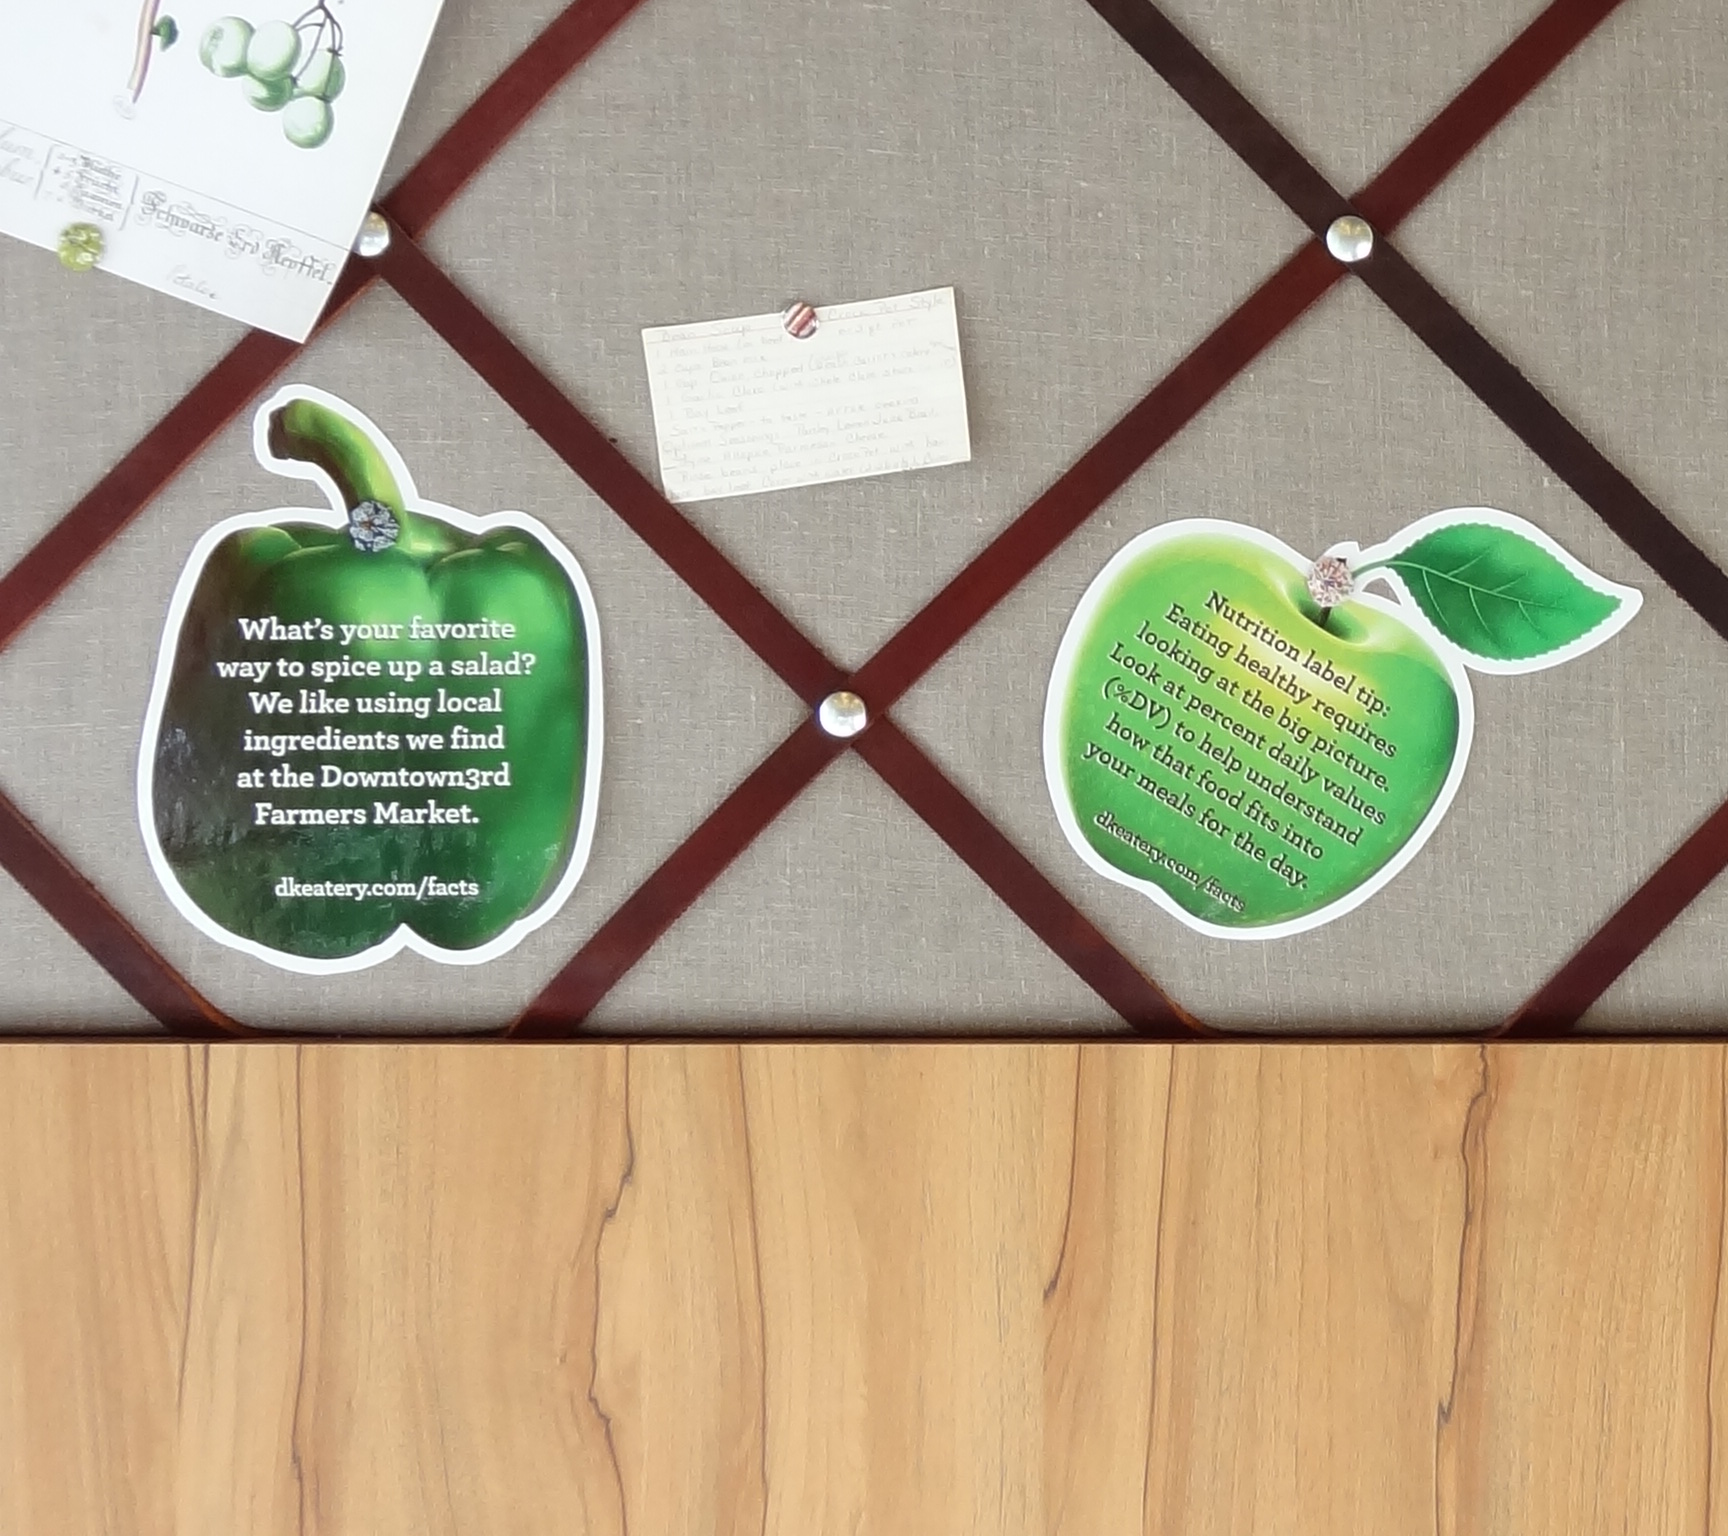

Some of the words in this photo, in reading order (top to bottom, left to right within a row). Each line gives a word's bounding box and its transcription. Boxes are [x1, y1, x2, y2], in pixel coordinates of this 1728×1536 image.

[238, 616, 334, 642] What's
[339, 622, 404, 647] your
[408, 616, 516, 641] favorite
[216, 660, 272, 684] way
[276, 657, 305, 678] to
[310, 653, 382, 684] spice
[387, 659, 425, 684] up
[429, 658, 446, 677] a
[450, 651, 537, 677] salad?
[1201, 589, 1302, 666] Nutrition
[1301, 648, 1357, 698] label
[1355, 680, 1393, 719] tip:
[1164, 601, 1234, 659] Eating
[1235, 640, 1312, 706] healthy
[1309, 693, 1398, 759] requires
[248, 691, 295, 715] We
[299, 689, 351, 714] like
[355, 690, 432, 719] using
[436, 688, 503, 713] local
[1134, 619, 1215, 683] looking
[1216, 674, 1241, 699] at
[1241, 686, 1276, 722] the
[1277, 704, 1313, 745] big
[1310, 725, 1391, 793] picture.
[242, 727, 400, 756] ingredients
[405, 731, 444, 750] we
[449, 725, 505, 750] find
[236, 767, 265, 789] at
[269, 763, 315, 789] the
[319, 761, 512, 790] Downtown3rd
[1099, 675, 1174, 731] (%DV)
[1173, 715, 1197, 744] to
[1197, 727, 1244, 776] help
[1245, 757, 1364, 848] understand
[254, 802, 368, 826] Farmers
[373, 800, 480, 826] Market.
[1082, 741, 1137, 782] your
[1136, 768, 1198, 820] meals
[1198, 808, 1230, 840] for
[1233, 827, 1267, 863] the
[1268, 845, 1312, 890] day.
[1093, 809, 1247, 913] dkeatery.com/facts
[274, 875, 480, 900] dkeatery.com/facts
